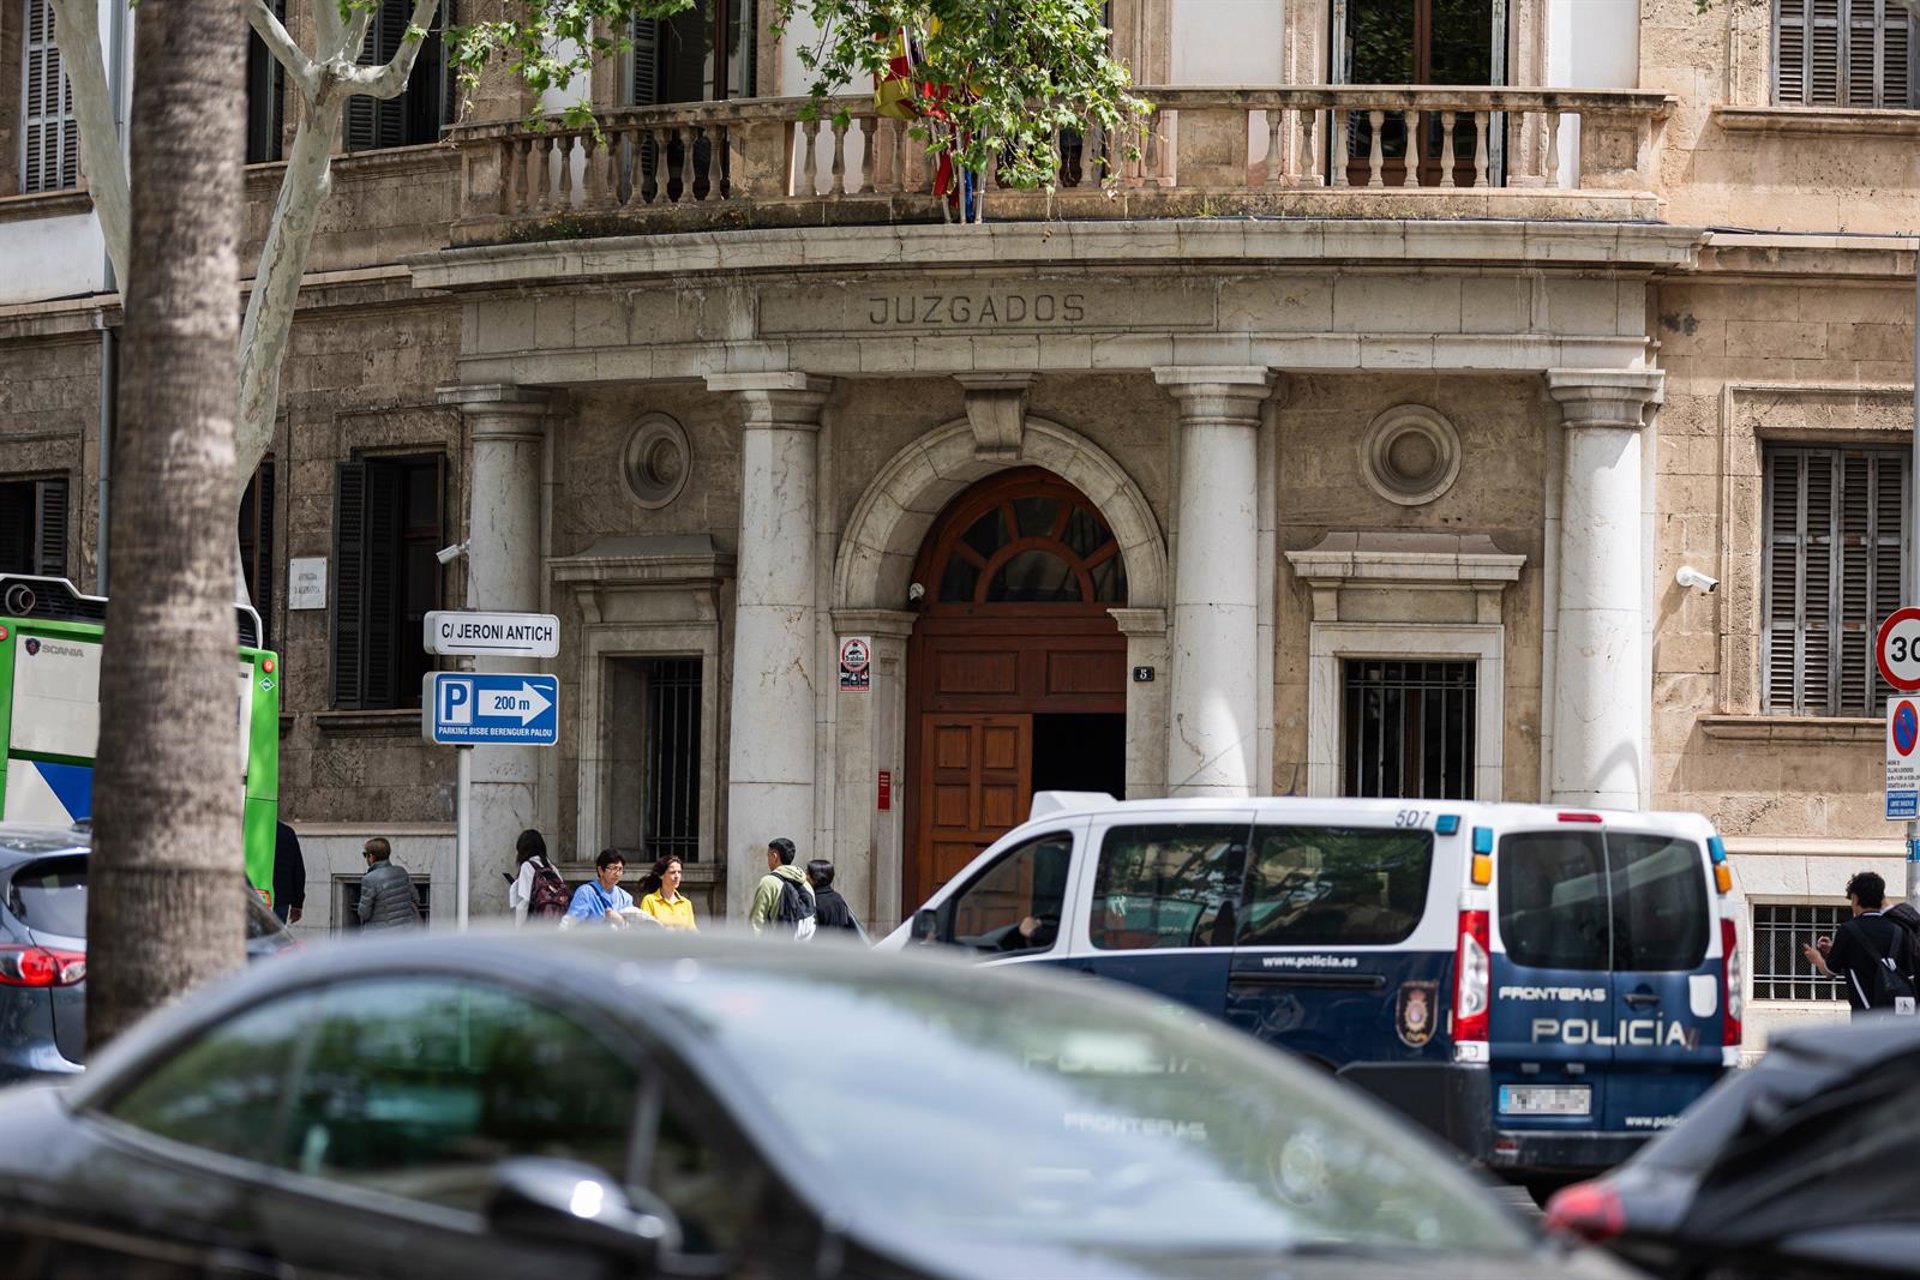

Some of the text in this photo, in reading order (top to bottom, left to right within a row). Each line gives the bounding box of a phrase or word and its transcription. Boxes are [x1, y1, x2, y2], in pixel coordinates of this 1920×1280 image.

[869, 294, 1085, 324] JUZGADOS
[441, 623, 553, 641] C/ JERONI ANTICH
[42, 644, 84, 658] SCANIA
[1891, 636, 1920, 662] 30
[1140, 669, 1147, 679] 5
[445, 683, 467, 720] P
[494, 696, 530, 711] 200 m
[438, 727, 553, 738] PARKING BISBE BERENGUER PALOU
[1263, 955, 1358, 969] www.policia.es
[1499, 986, 1606, 1002] FRONTERAS
[1531, 1012, 1687, 1045] POLICÍA
